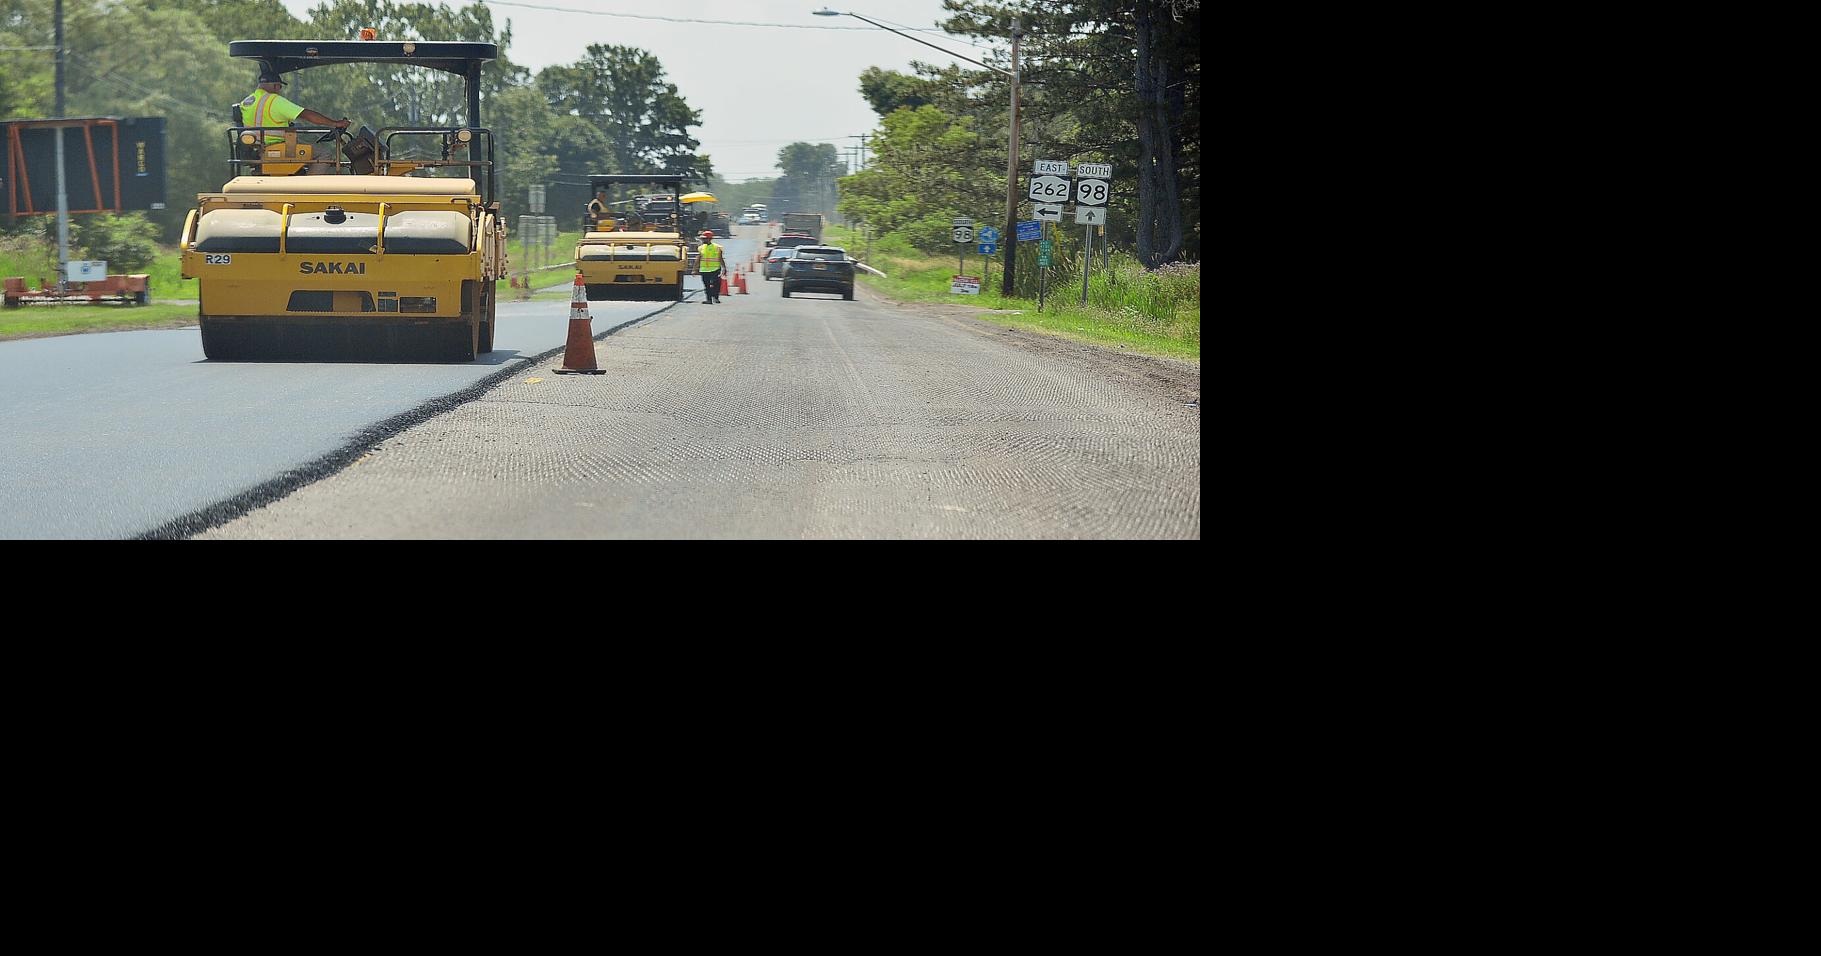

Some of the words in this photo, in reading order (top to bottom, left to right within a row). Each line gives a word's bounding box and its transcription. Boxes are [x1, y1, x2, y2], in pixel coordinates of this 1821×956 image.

[1039, 163, 1062, 172] EAST
[1079, 166, 1109, 175] SOUTH
[1032, 182, 1067, 197] 262
[1080, 184, 1105, 200] 98
[955, 230, 971, 240] 98
[206, 255, 231, 264] R29
[299, 262, 365, 274] SAKAI
